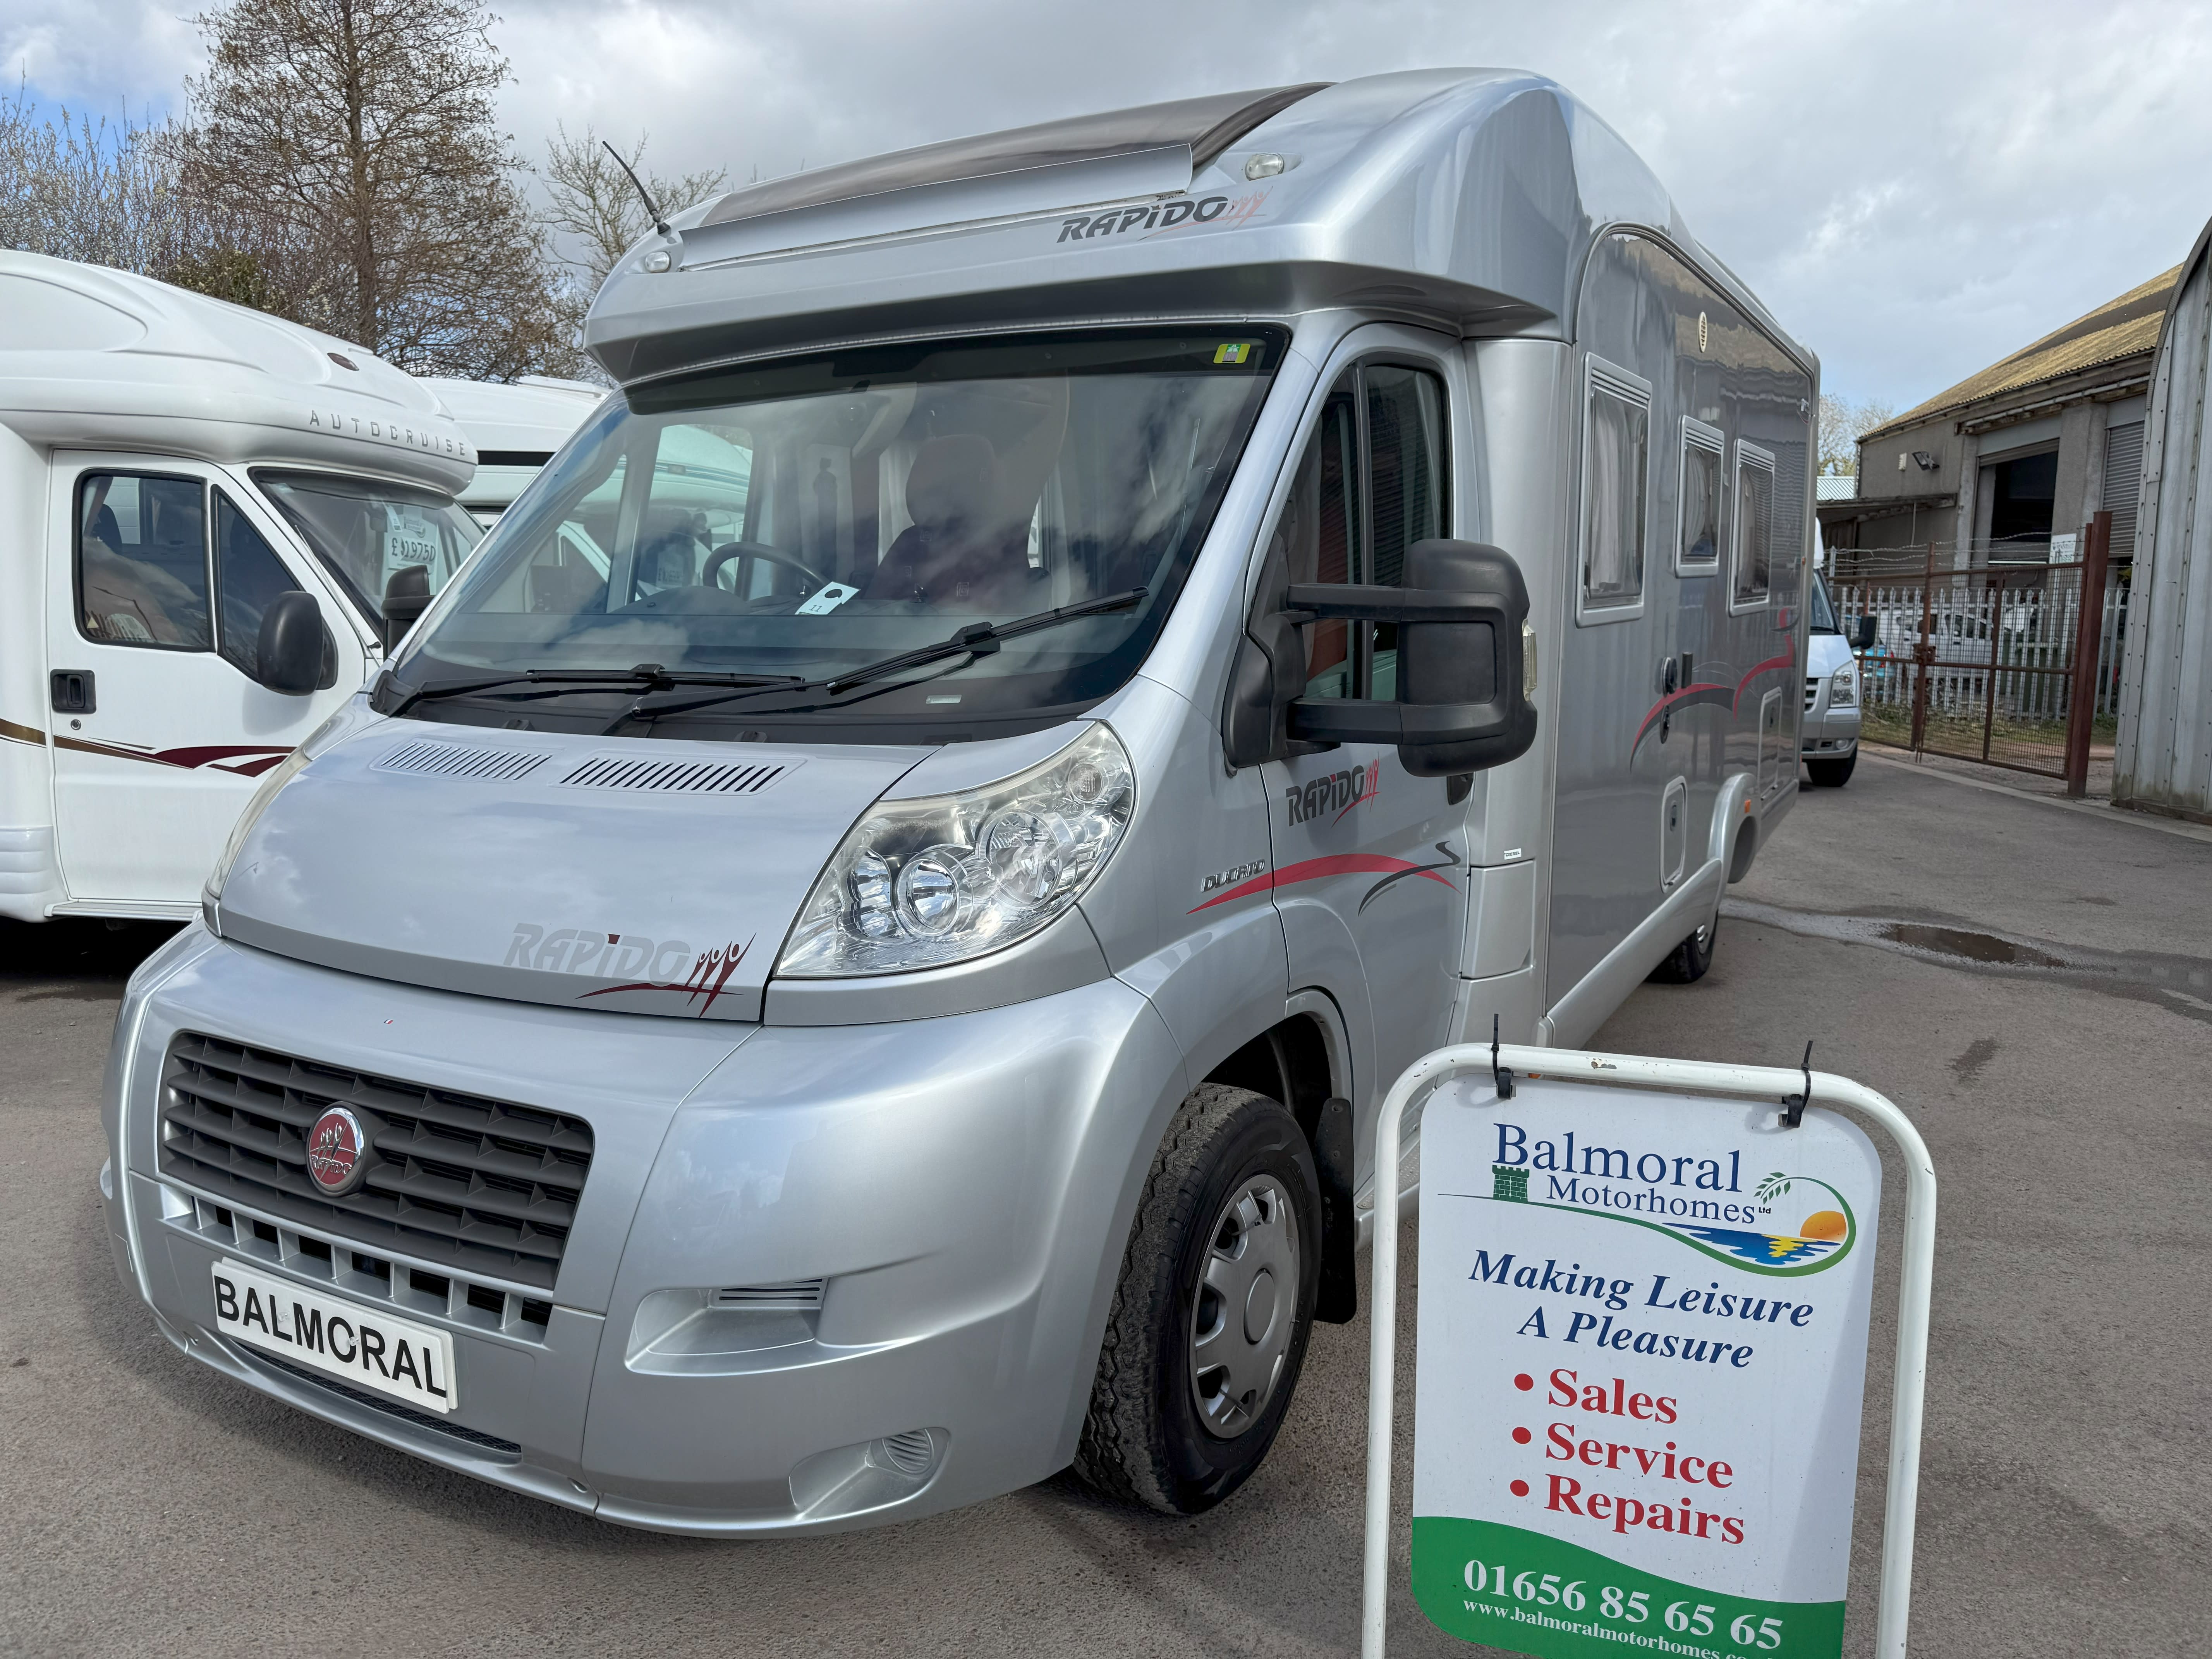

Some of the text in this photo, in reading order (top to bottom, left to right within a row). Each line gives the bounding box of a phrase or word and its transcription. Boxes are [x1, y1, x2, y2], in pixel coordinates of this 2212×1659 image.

[309, 410, 465, 456] AUTOCRUISE
[1201, 859, 1265, 893] DUCATO
[1492, 1123, 1742, 1193] Balmoral
[1547, 1175, 1755, 1224] Motorhomes
[1468, 1250, 1814, 1327] Making Leisure
[214, 1275, 447, 1398] BALMORAL
[1516, 1306, 1753, 1368] A Pleasure
[1548, 1369, 1677, 1424] Sales
[1546, 1423, 1733, 1489] Service
[1544, 1474, 1744, 1544] Repairs
[1464, 1559, 1783, 1650] 01656 85 65 65
